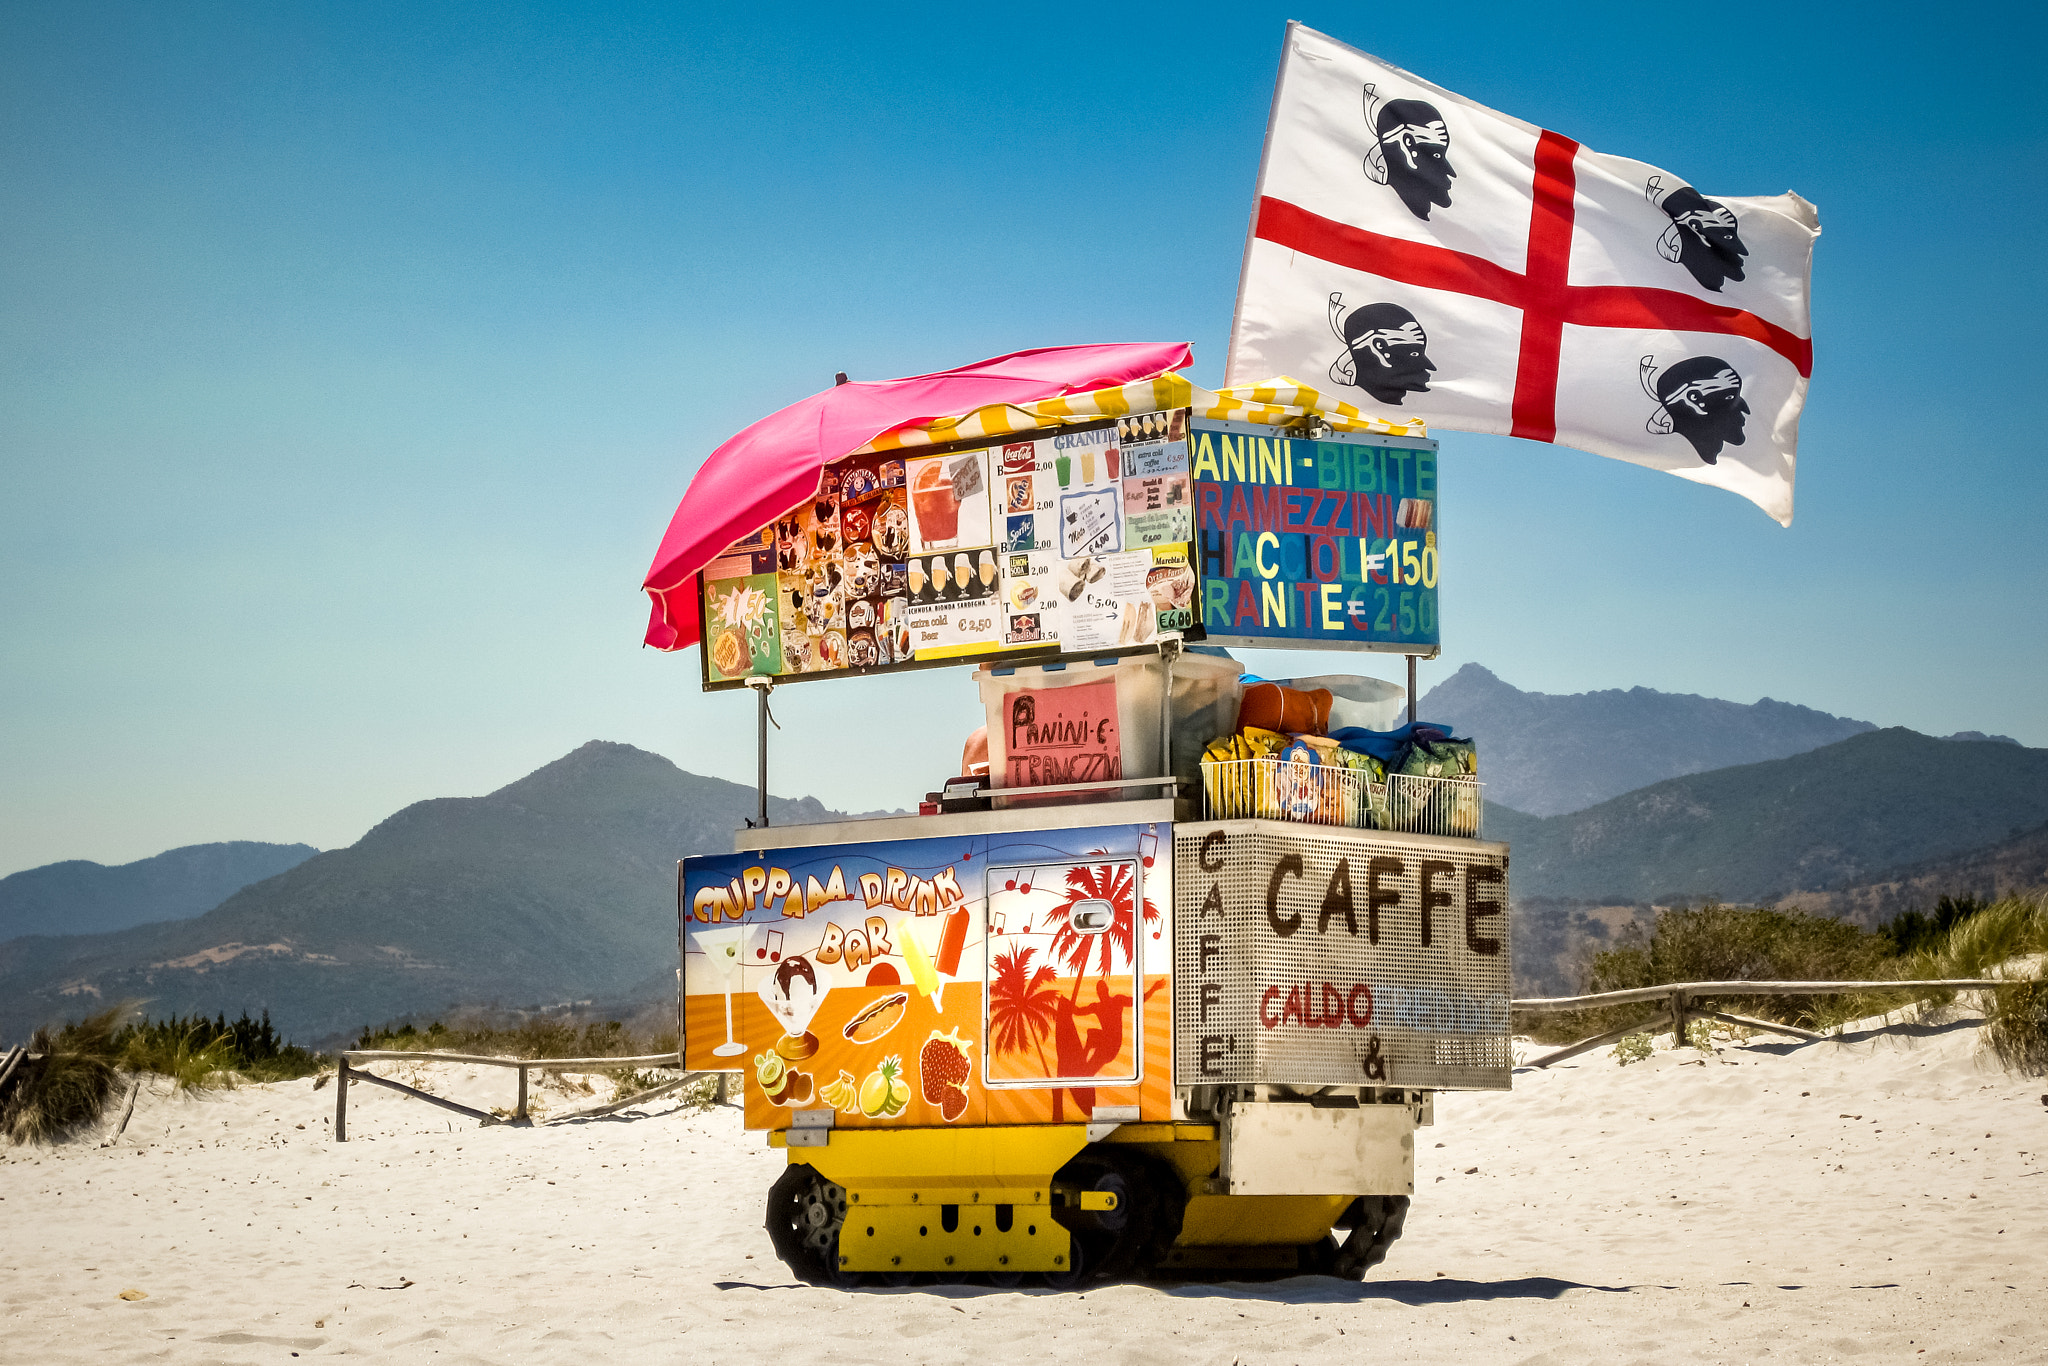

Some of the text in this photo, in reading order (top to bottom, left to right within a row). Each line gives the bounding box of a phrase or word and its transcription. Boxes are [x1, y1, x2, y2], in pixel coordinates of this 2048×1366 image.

[1054, 428, 1118, 450] GRANITE
[1035, 461, 1053, 471] 2,00
[1317, 441, 1435, 499] BIBITE
[1011, 480, 1028, 509] Fanta
[1037, 500, 1054, 510] 2,00
[1195, 481, 1394, 539] RAMEZZINI
[1010, 520, 1031, 543] Sprite
[1034, 540, 1052, 550] 2,00
[1089, 533, 1110, 554] € 4,00
[1202, 530, 1367, 585] HIACCIOLI
[1031, 566, 1048, 576] 2,00
[934, 603, 956, 612] BIONDA
[1040, 601, 1058, 611] 2,00
[1088, 593, 1118, 610] € 5,00
[1202, 579, 1344, 631] RANITE
[910, 614, 948, 629] extra cold
[958, 618, 992, 632] € 2,50
[921, 630, 939, 642] Beer
[1011, 628, 1040, 643] Red Bull
[1041, 631, 1058, 641] 3,50
[859, 866, 964, 917] DRINK
[816, 916, 892, 972] BAR
[1260, 980, 1374, 1030] CALDO
[1362, 1035, 1388, 1082] &
